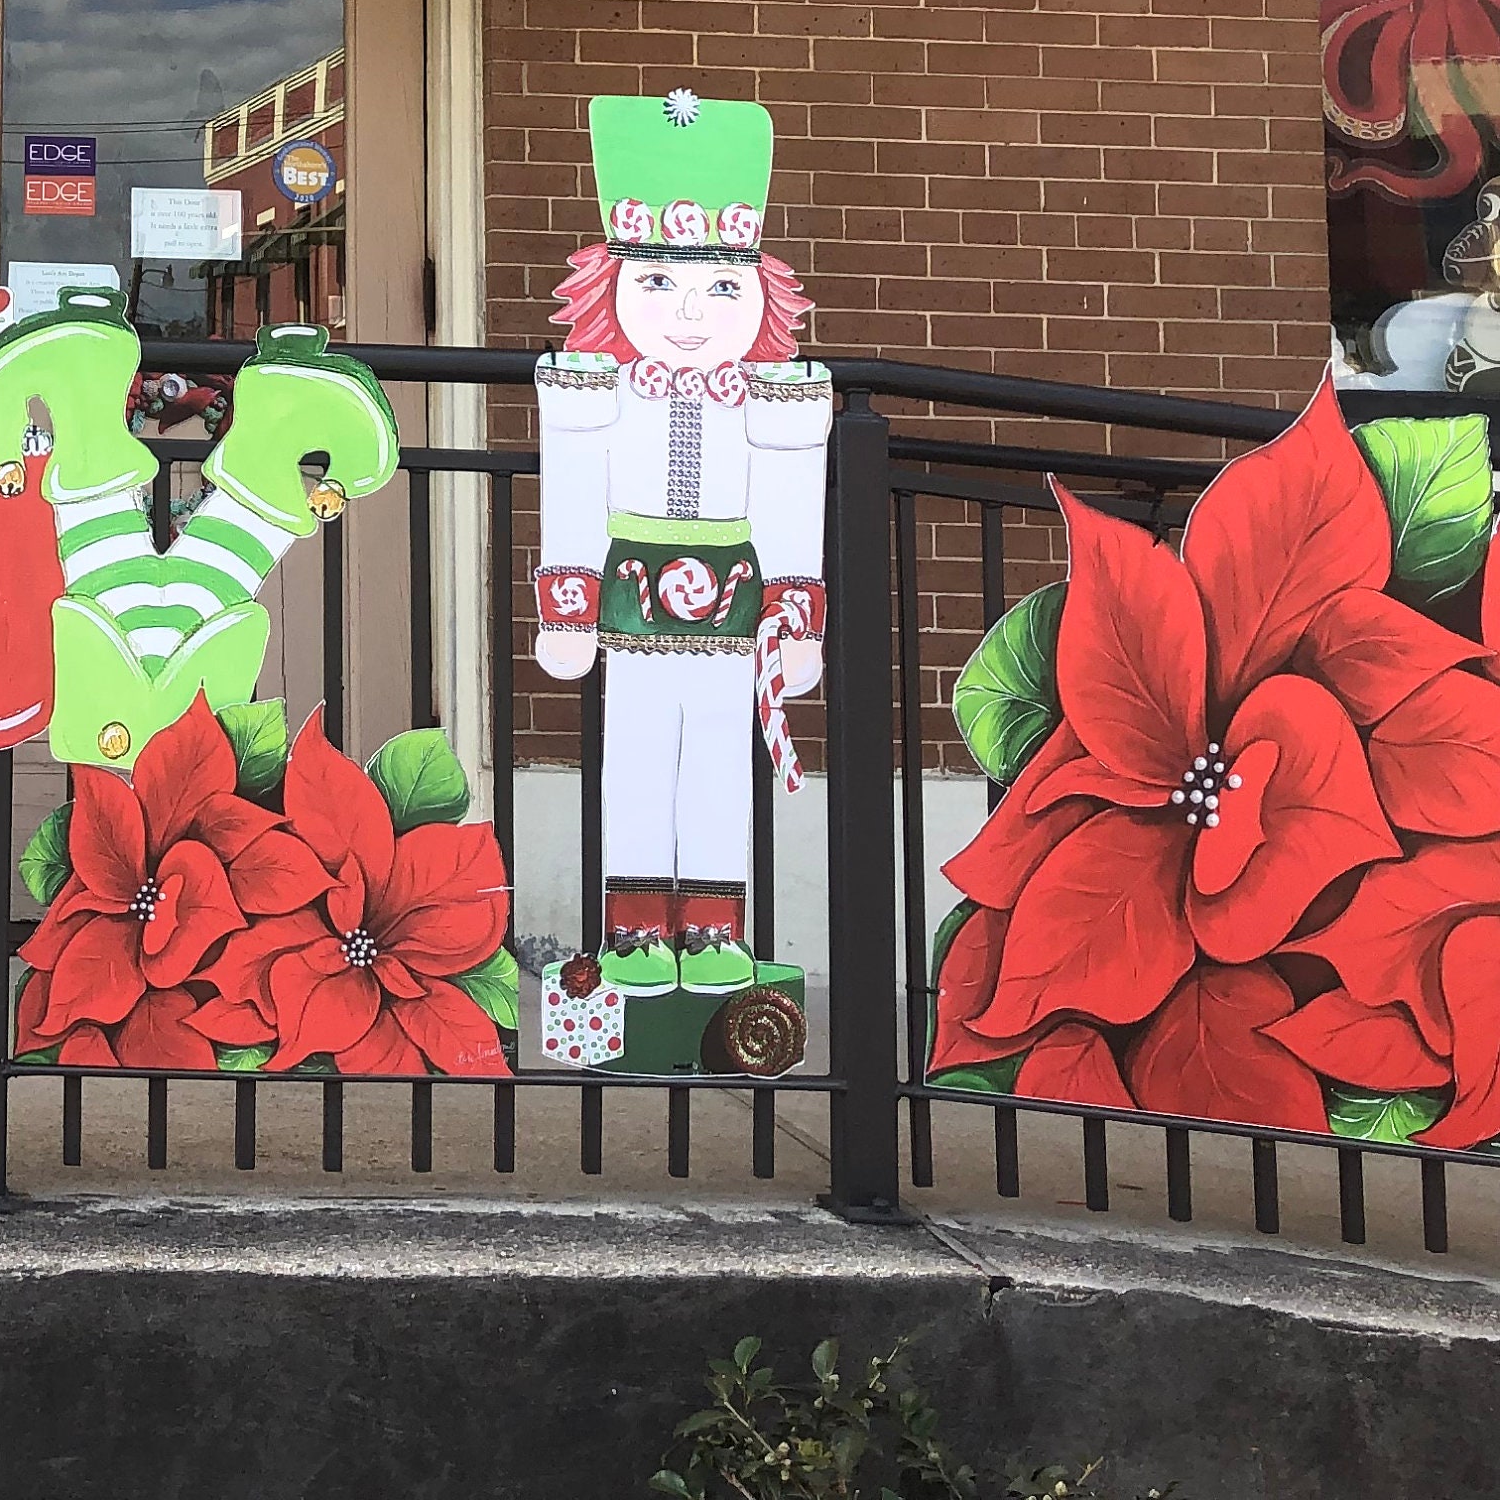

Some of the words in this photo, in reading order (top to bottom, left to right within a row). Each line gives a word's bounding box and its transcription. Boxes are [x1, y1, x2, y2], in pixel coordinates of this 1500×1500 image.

[29, 143, 92, 162] EDGE
[283, 166, 329, 186] BEST
[26, 181, 93, 202] EDGE
